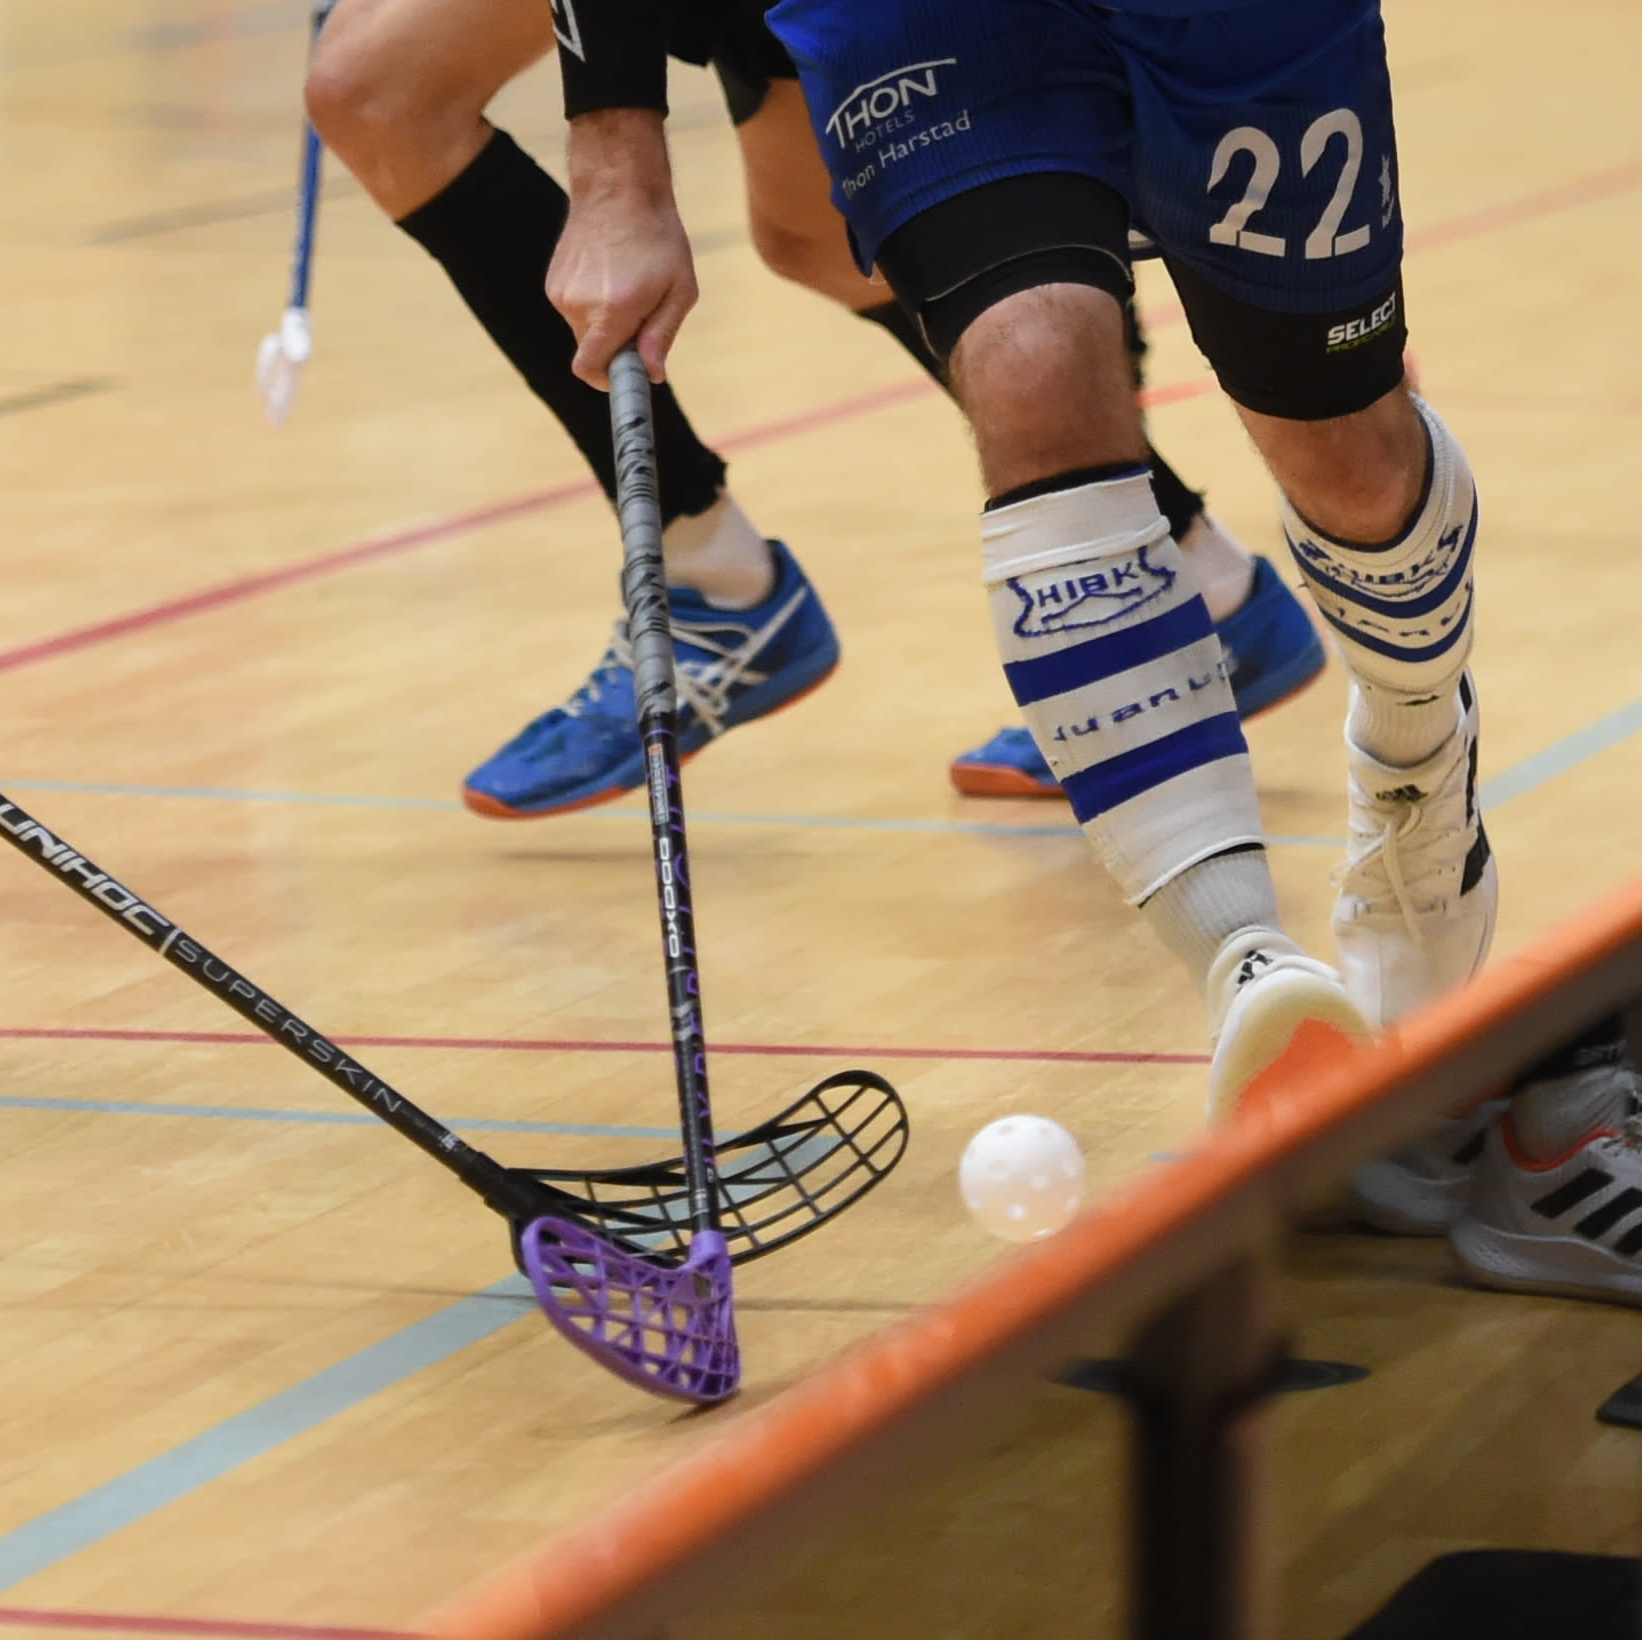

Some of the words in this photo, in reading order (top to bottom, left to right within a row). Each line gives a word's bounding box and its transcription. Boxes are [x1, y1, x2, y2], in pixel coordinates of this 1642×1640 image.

[825, 58, 956, 150] THON
[855, 110, 916, 155] HOTELS
[878, 109, 971, 169] Harstad
[1206, 106, 1371, 260] 22
[1327, 290, 1396, 346] SELECT
[1037, 560, 1139, 608] HIBK
[173, 938, 403, 1114] SUPERSKIN
